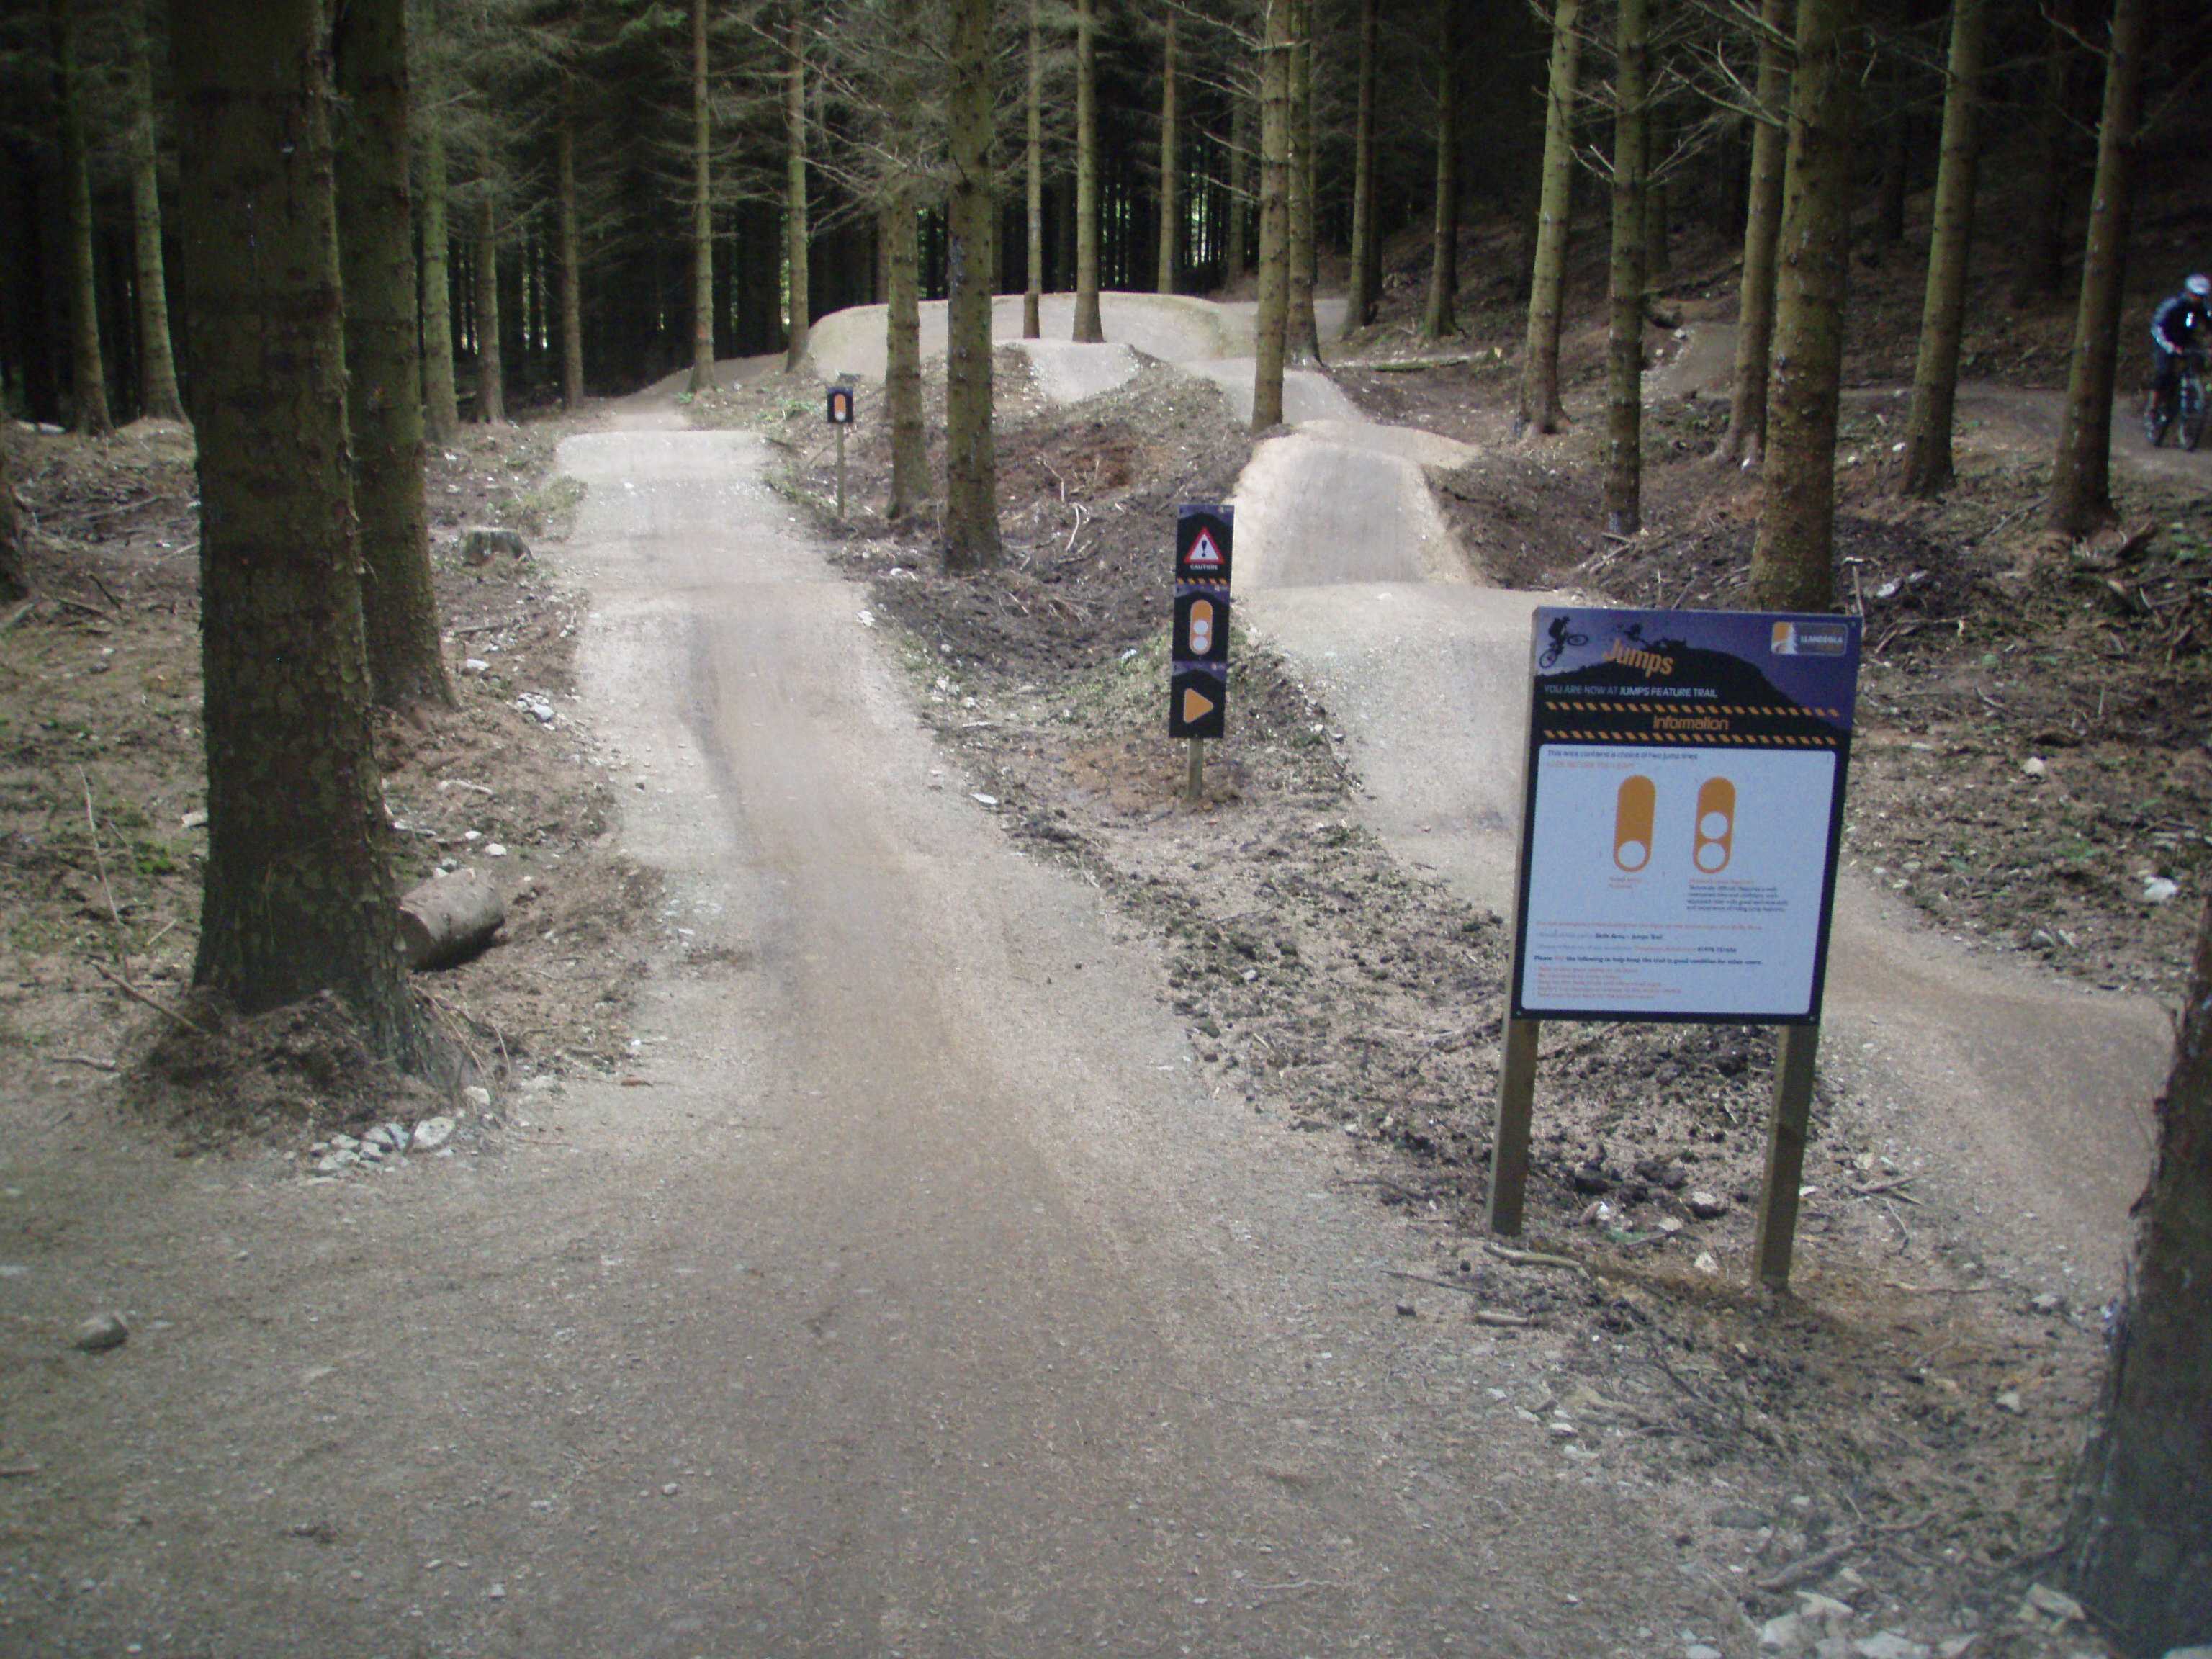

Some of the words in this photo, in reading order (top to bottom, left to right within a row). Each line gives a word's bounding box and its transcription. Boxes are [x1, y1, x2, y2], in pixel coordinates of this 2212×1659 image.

[1602, 637, 1674, 678] Jumps
[1544, 685, 1562, 694] YOU
[1565, 685, 1582, 694] ARE
[1584, 685, 1605, 695] NOW
[1607, 686, 1619, 695] AT
[1619, 686, 1650, 696] JUMPS
[1651, 687, 1691, 697] FEATURE
[1693, 688, 1718, 698] TRAIL
[1653, 714, 1729, 730] Information
